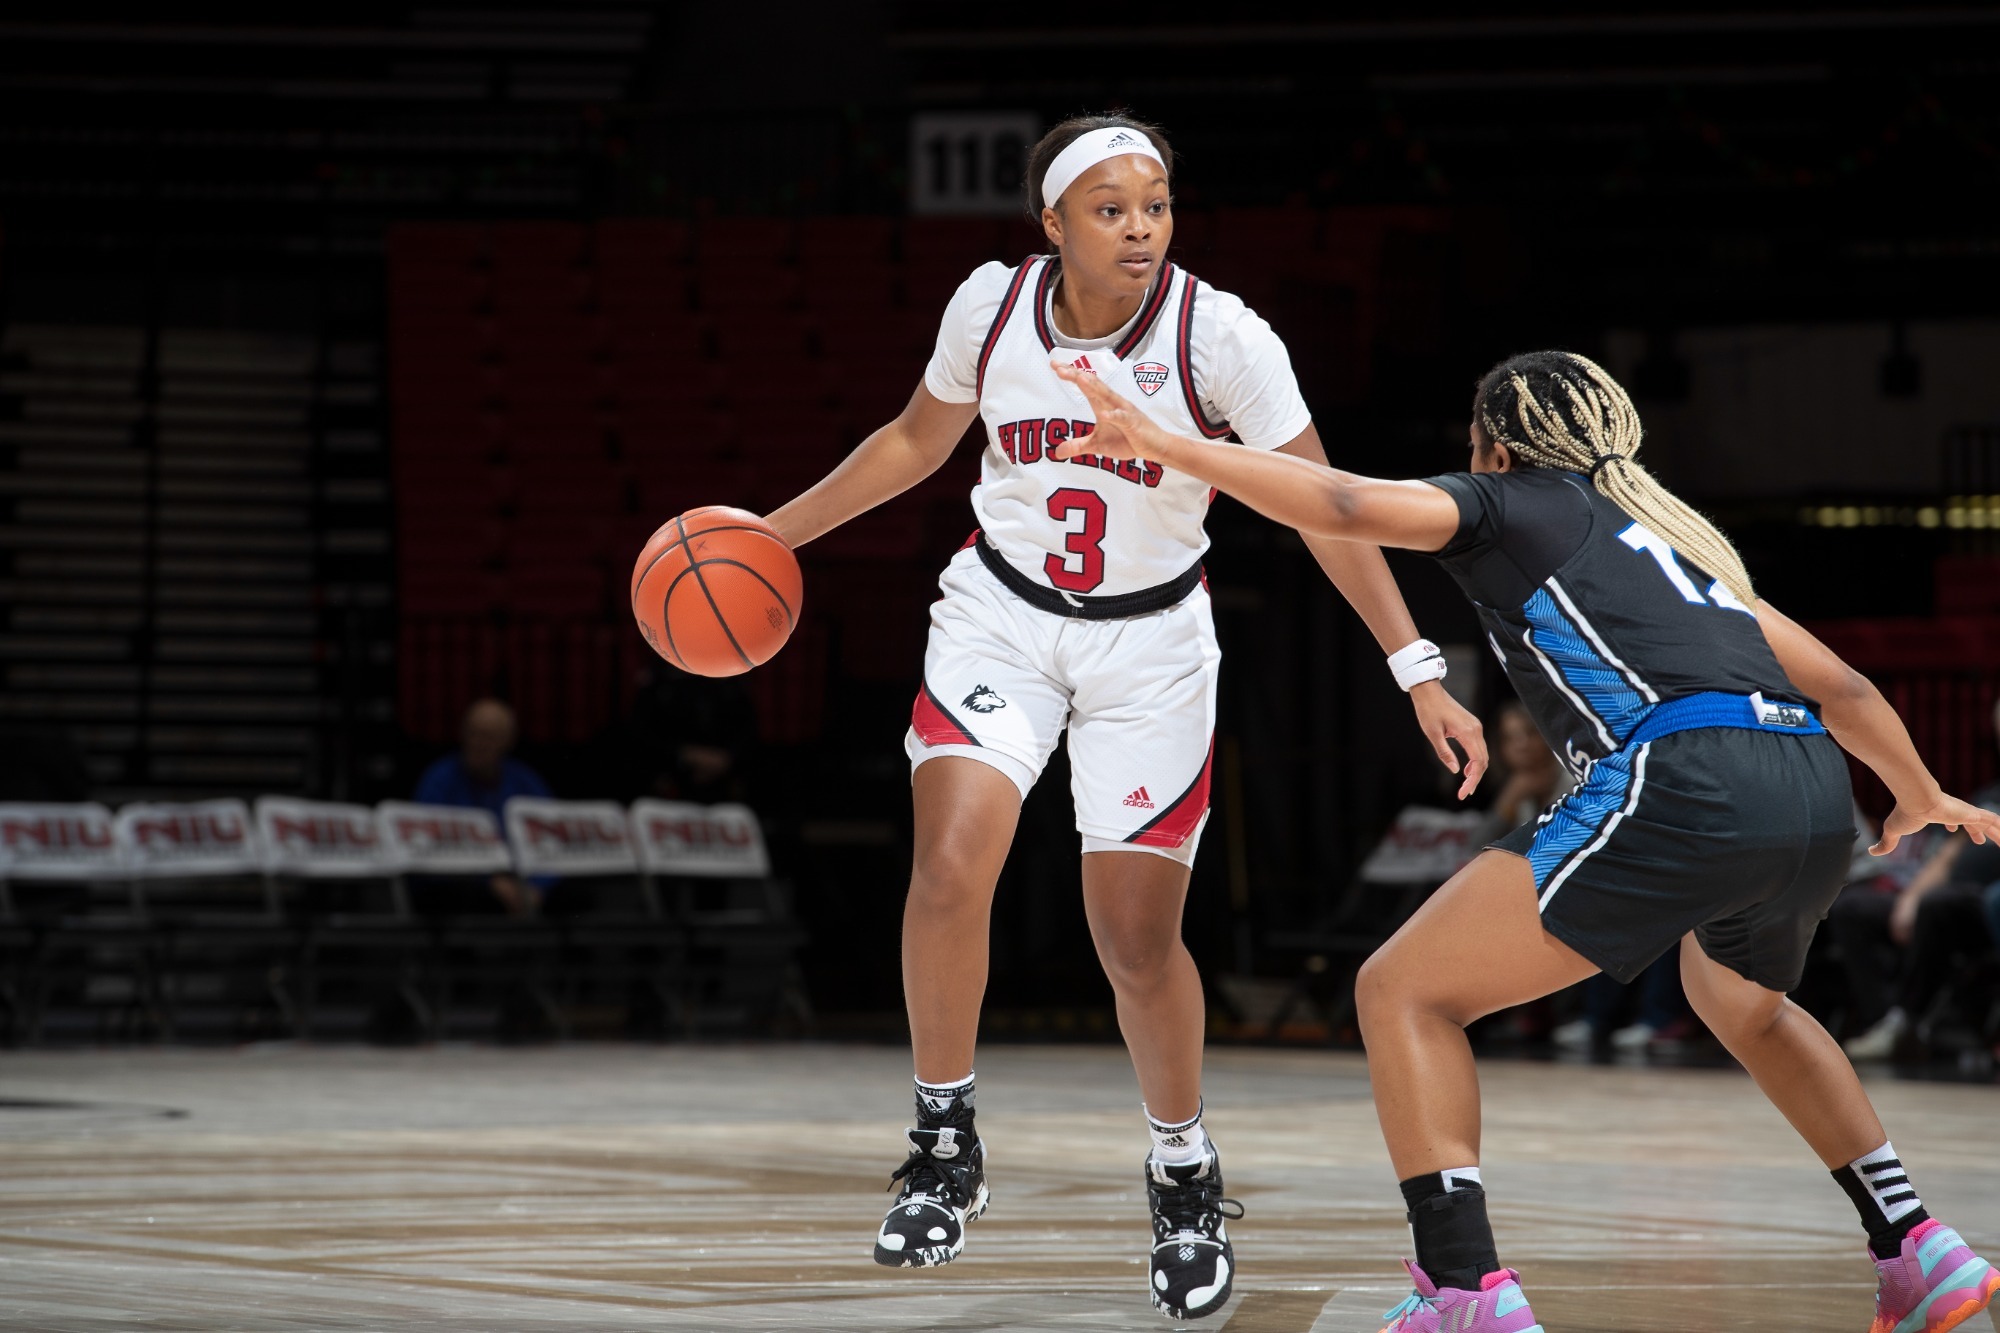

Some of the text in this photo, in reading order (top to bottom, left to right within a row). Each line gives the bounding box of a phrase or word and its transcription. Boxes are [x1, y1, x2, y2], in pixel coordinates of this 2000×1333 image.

[1135, 372, 1168, 382] MAC
[1043, 487, 1107, 594] 3
[1122, 799, 1155, 809] adidas
[2, 817, 112, 848] NIU
[132, 814, 244, 843] NIU
[273, 815, 378, 847] NIU
[1161, 1139, 1190, 1148] adidas
